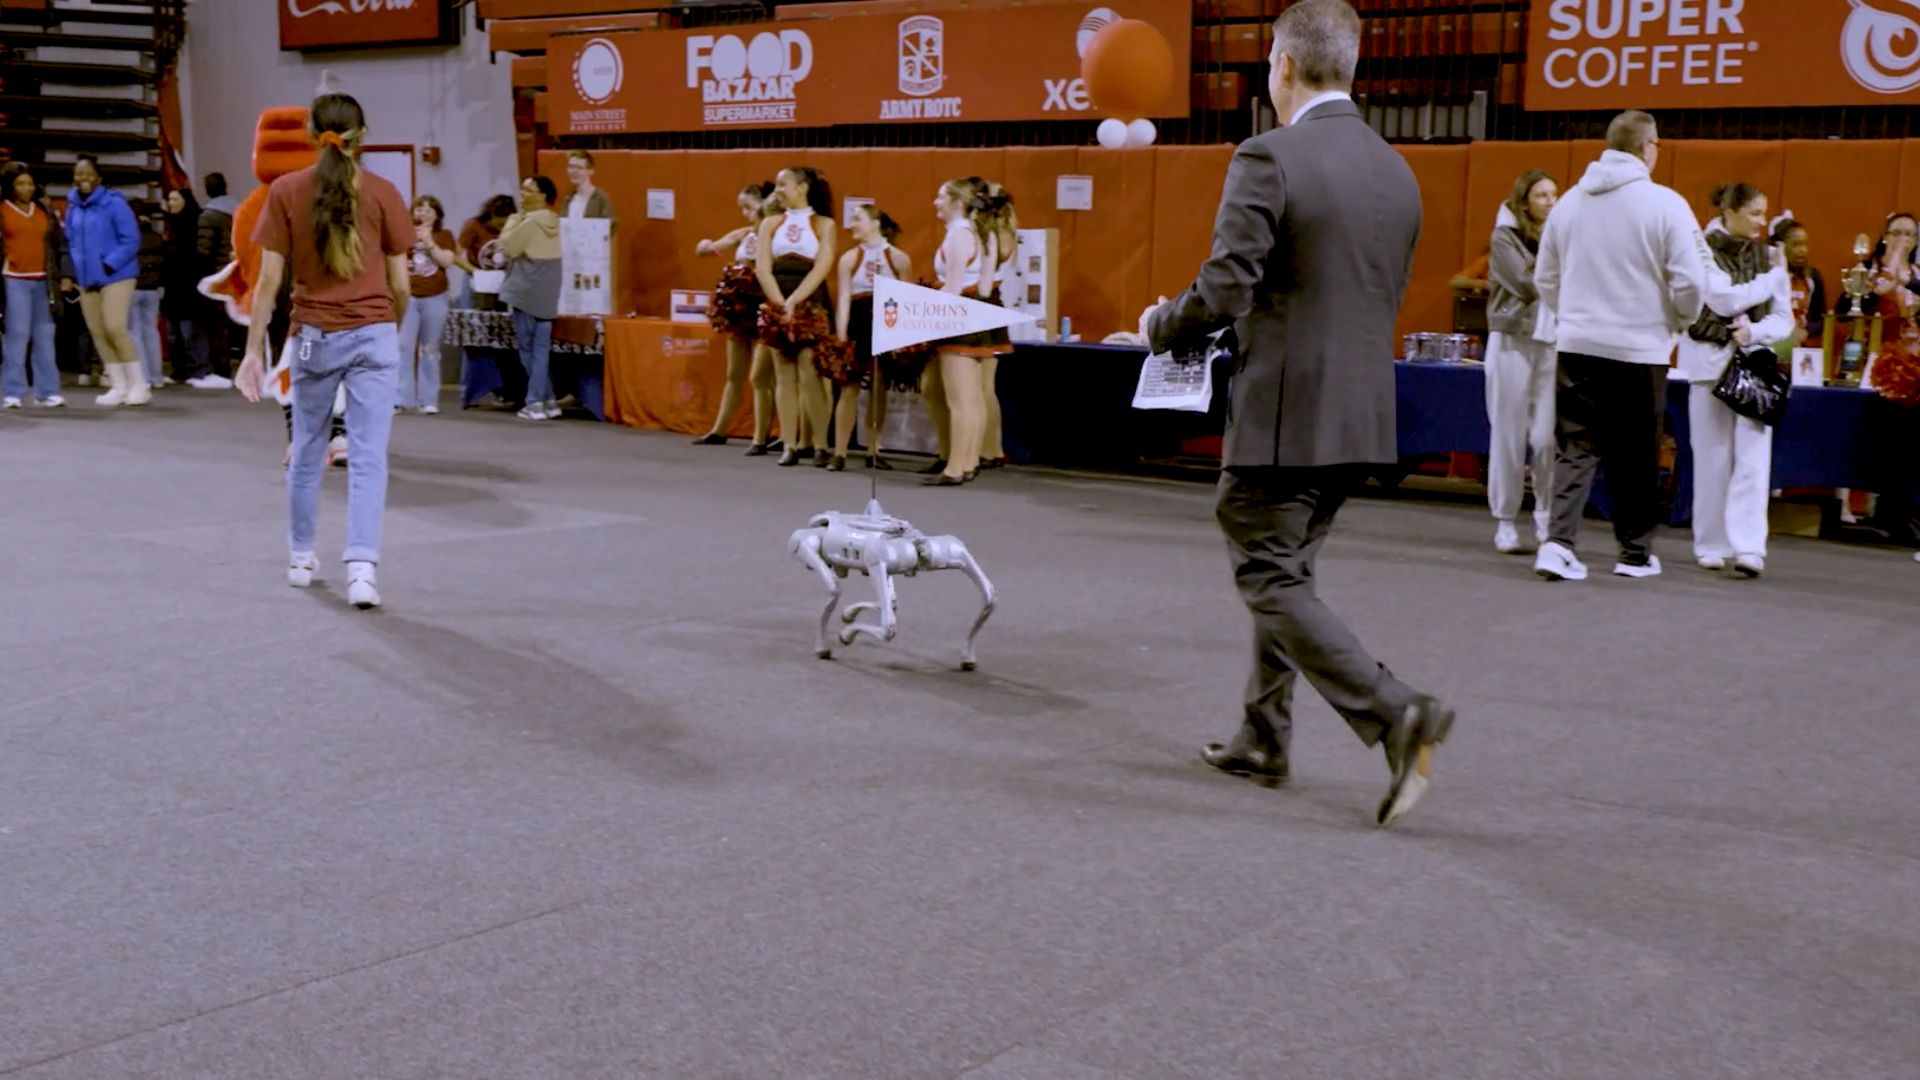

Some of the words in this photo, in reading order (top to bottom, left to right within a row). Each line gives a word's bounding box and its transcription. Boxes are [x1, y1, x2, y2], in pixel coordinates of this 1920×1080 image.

[1547, 0, 1745, 40] SUPER
[686, 29, 813, 88] FOOD
[1543, 43, 1745, 88] COFFEE
[702, 77, 796, 103] BAZAAR
[1042, 78, 1091, 111] xe
[703, 104, 796, 122] SUPERMARKET
[879, 99, 923, 119] ARMY
[923, 97, 962, 117] ROTC
